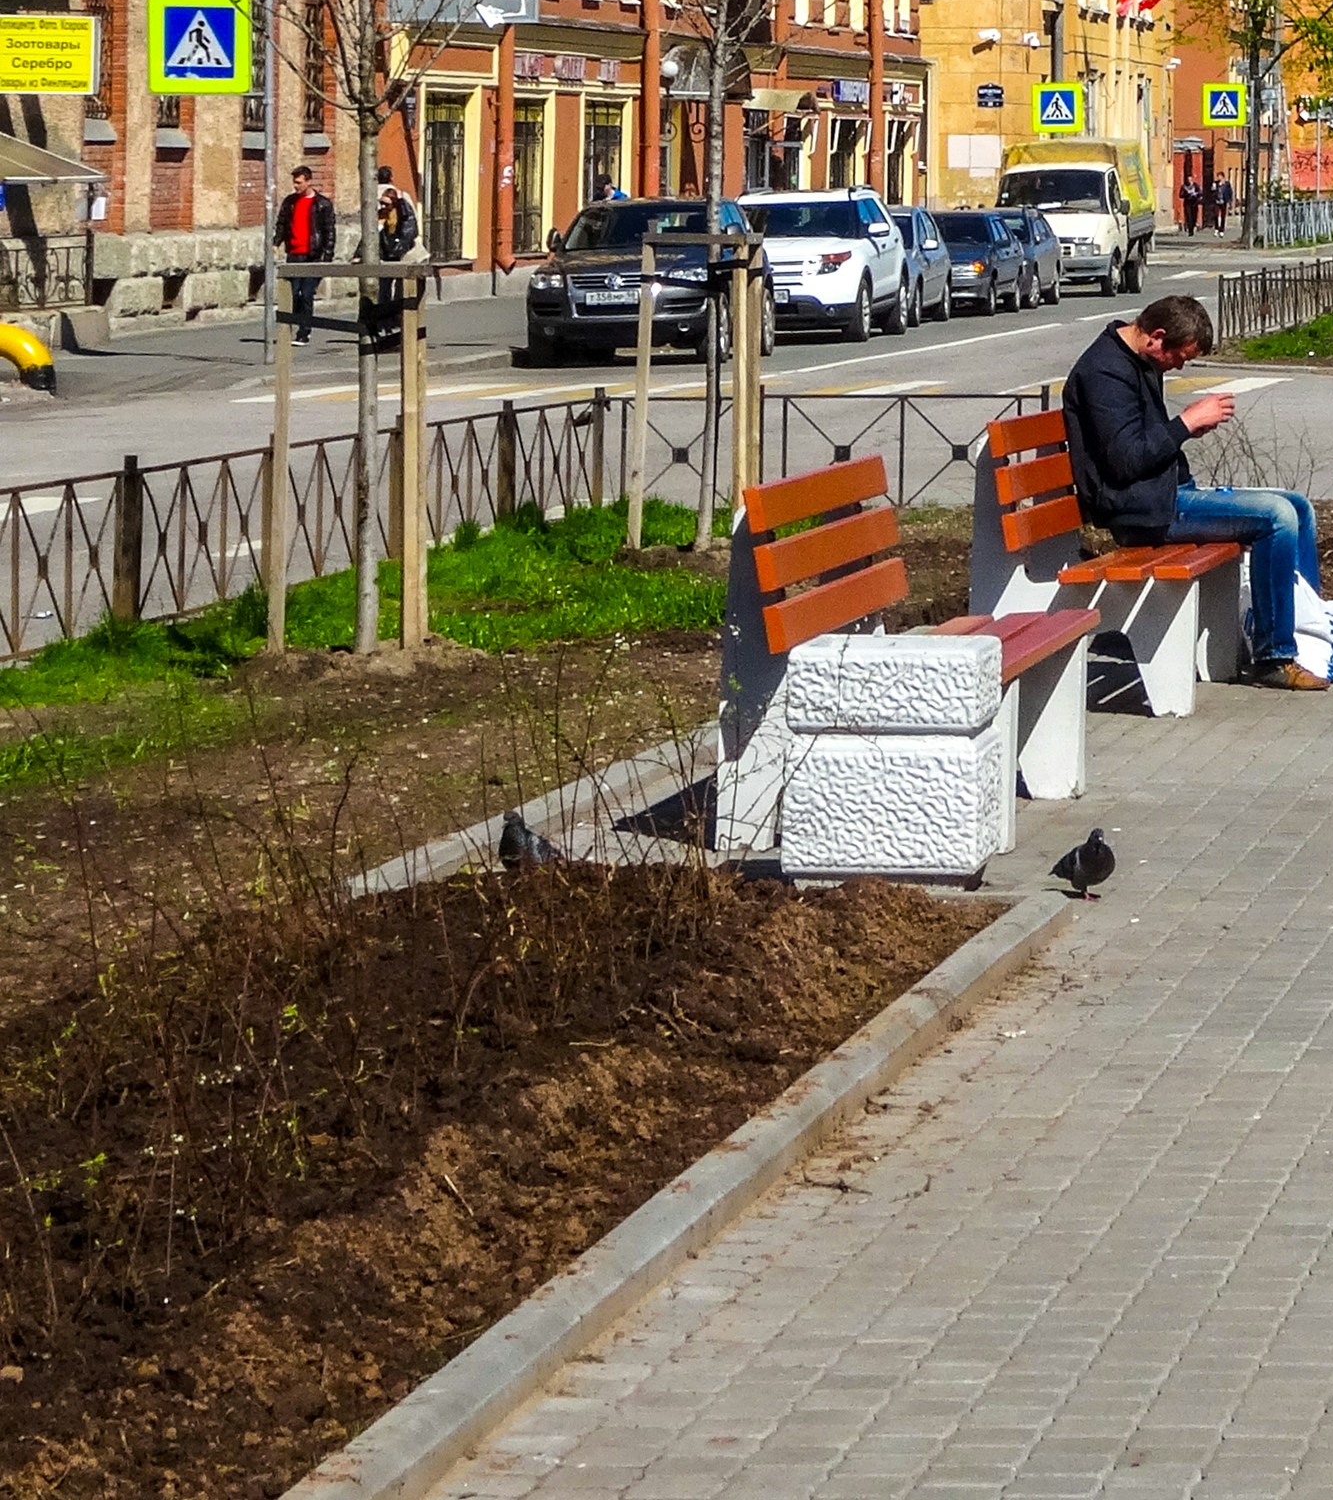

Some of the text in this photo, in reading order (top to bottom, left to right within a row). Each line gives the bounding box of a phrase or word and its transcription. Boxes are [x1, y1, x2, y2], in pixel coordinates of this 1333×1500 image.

[6, 37, 81, 52] Зоотовары
[12, 56, 73, 71] Серебро
[0, 77, 26, 90] овары
